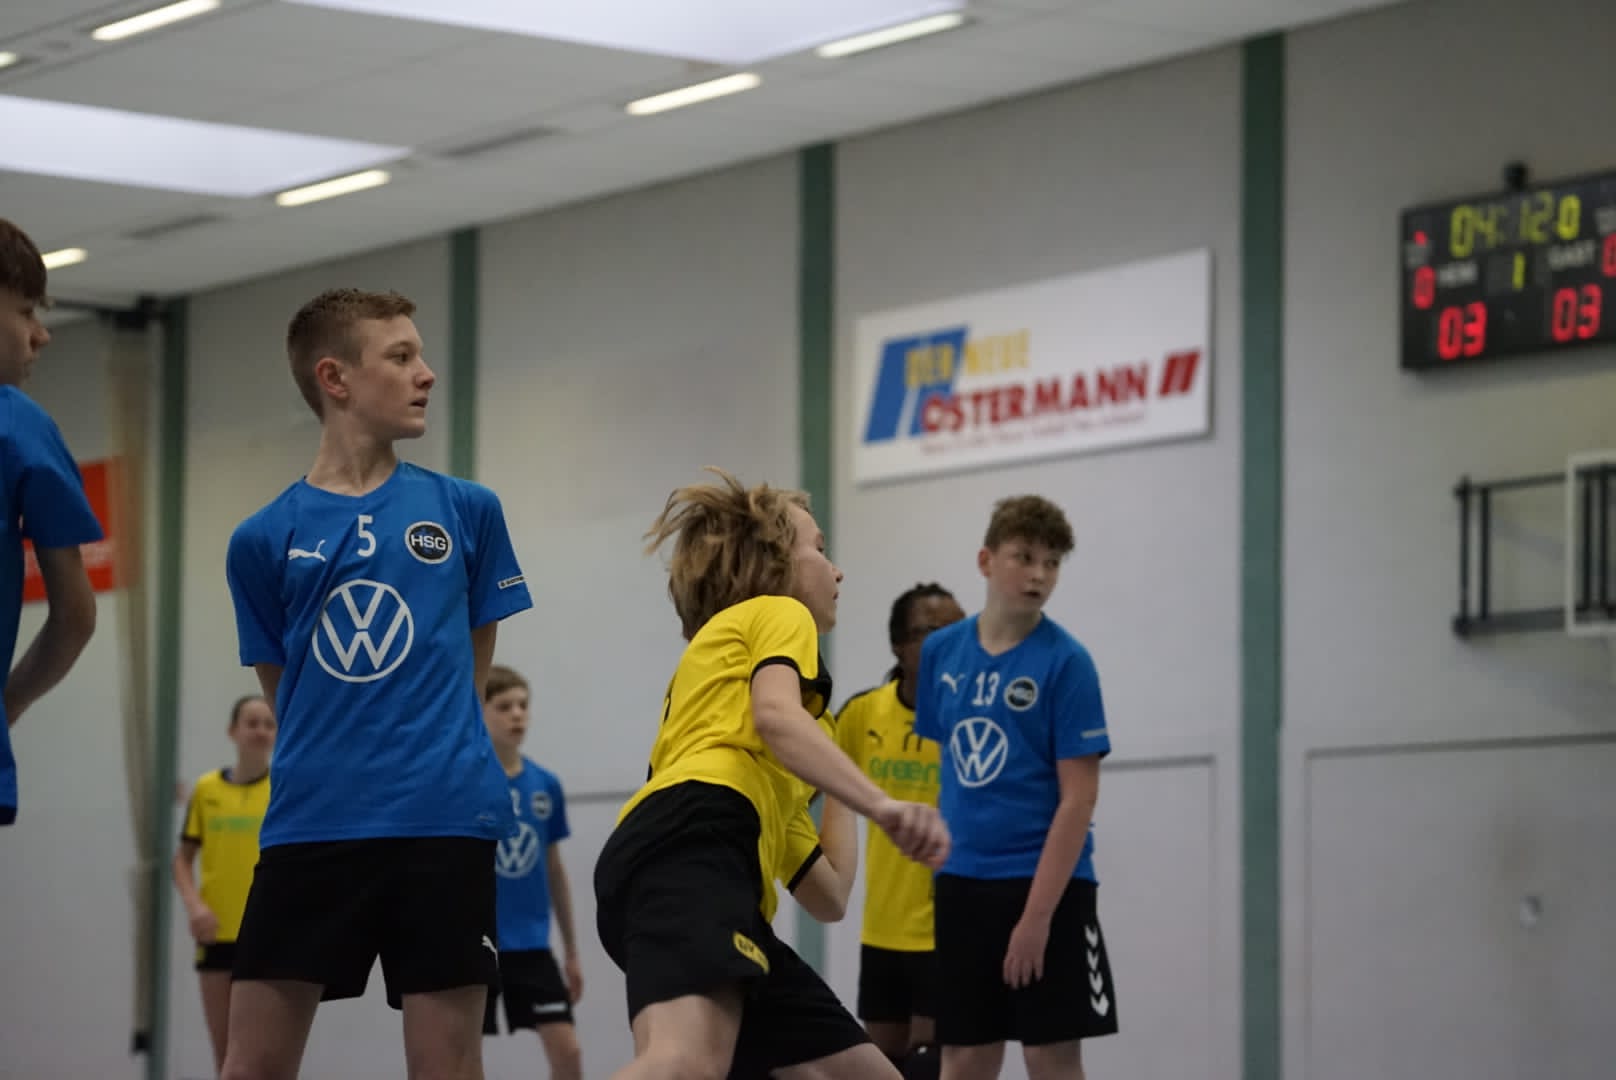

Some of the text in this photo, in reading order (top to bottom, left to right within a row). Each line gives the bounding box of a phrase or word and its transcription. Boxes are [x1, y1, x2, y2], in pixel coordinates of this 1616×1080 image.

[1437, 301, 1487, 359] 03
[1552, 283, 1602, 341] 03
[920, 362, 1150, 434] OSTERMANN
[357, 514, 377, 558] 5
[410, 533, 447, 552] HSG
[316, 581, 410, 674] VW
[971, 671, 1000, 707] 13
